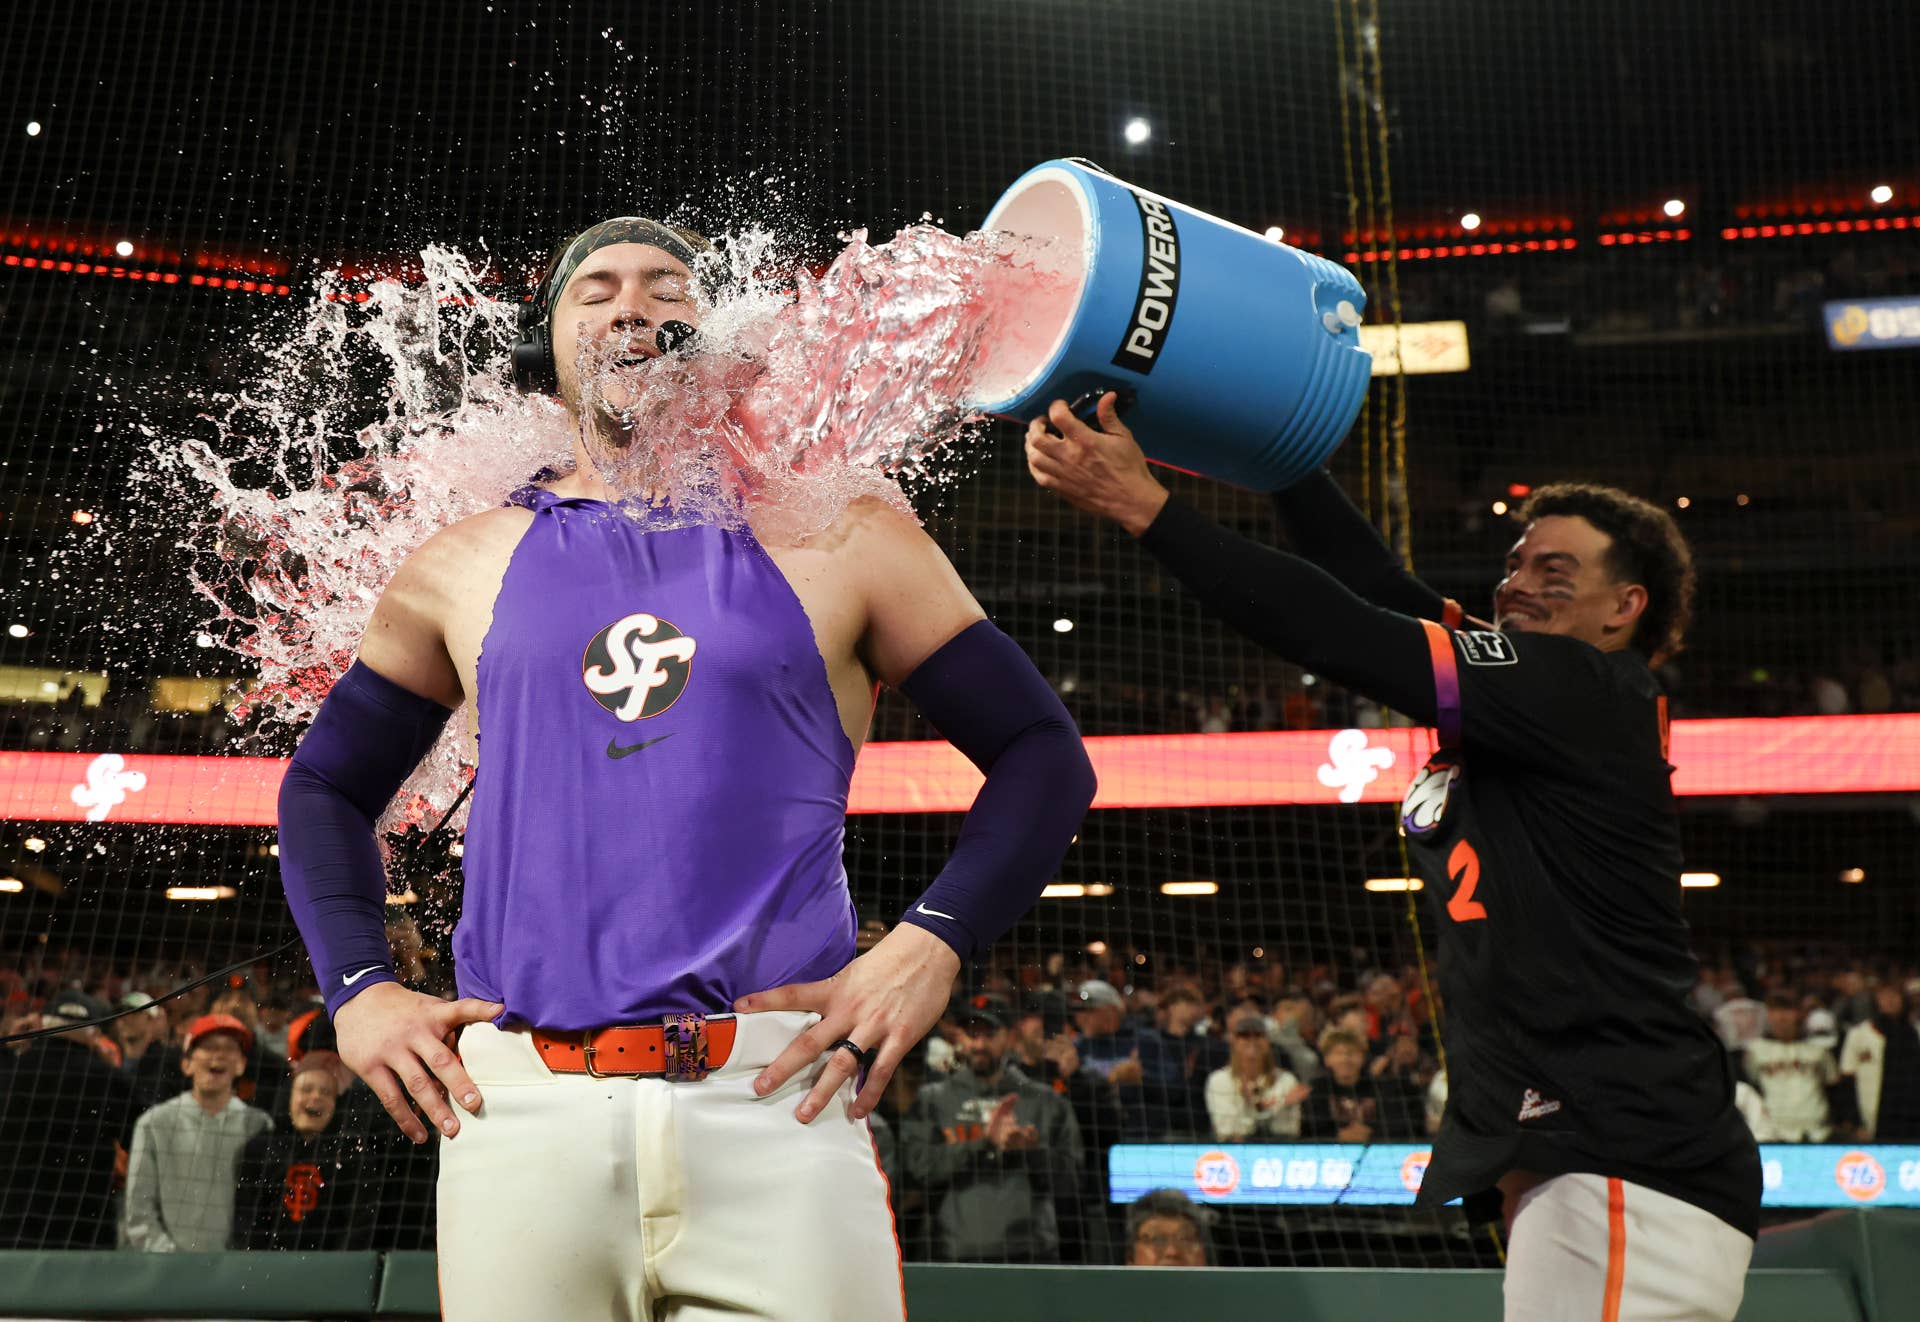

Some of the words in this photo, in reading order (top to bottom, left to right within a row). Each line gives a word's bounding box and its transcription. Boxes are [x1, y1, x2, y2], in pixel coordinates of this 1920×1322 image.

[583, 613, 697, 722] SF
[1447, 838, 1488, 922] 2
[283, 1164, 323, 1221] SF
[1847, 1164, 1876, 1185] 76
